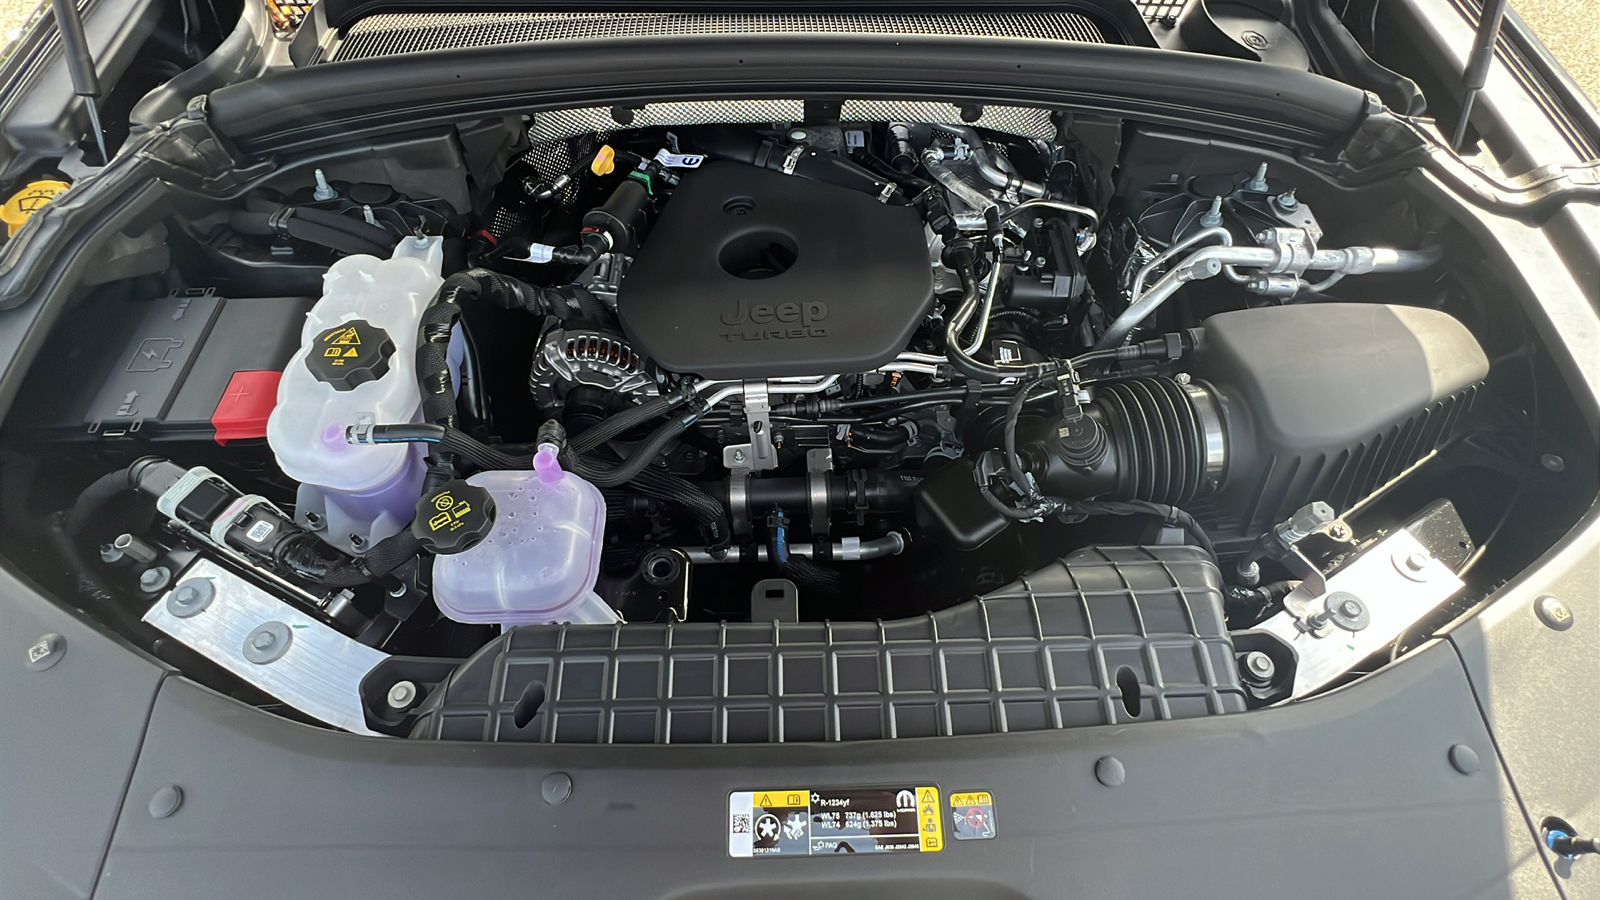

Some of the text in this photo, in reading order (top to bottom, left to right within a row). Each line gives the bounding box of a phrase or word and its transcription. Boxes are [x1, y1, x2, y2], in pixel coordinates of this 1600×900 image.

[720, 299, 828, 328] Jeep
[719, 328, 829, 342] TURBO
[820, 798, 850, 807] R-1234yf
[820, 810, 897, 820] WL75 737g (1.625 lbs)
[821, 819, 897, 829] WL74 624g (1.375 lbs)
